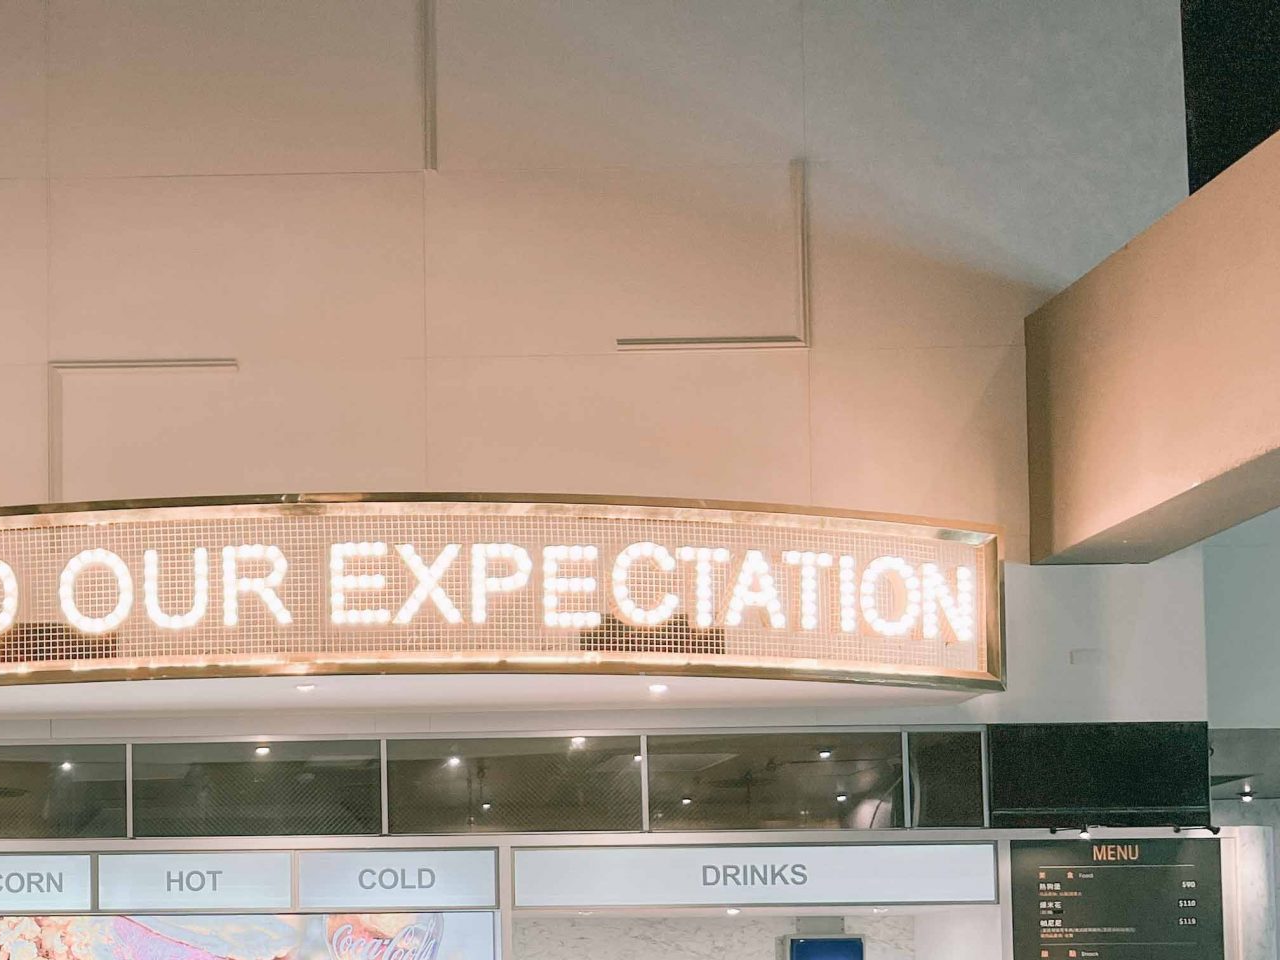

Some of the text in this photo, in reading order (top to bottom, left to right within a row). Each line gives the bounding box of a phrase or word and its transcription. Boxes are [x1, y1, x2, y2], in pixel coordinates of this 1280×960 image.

[57, 545, 293, 635] OUR
[330, 540, 974, 642] EXPECTATION
[1092, 844, 1139, 861] MENU
[166, 870, 223, 892] HOT
[357, 868, 437, 890] COLD
[701, 863, 809, 887] DRINKS
